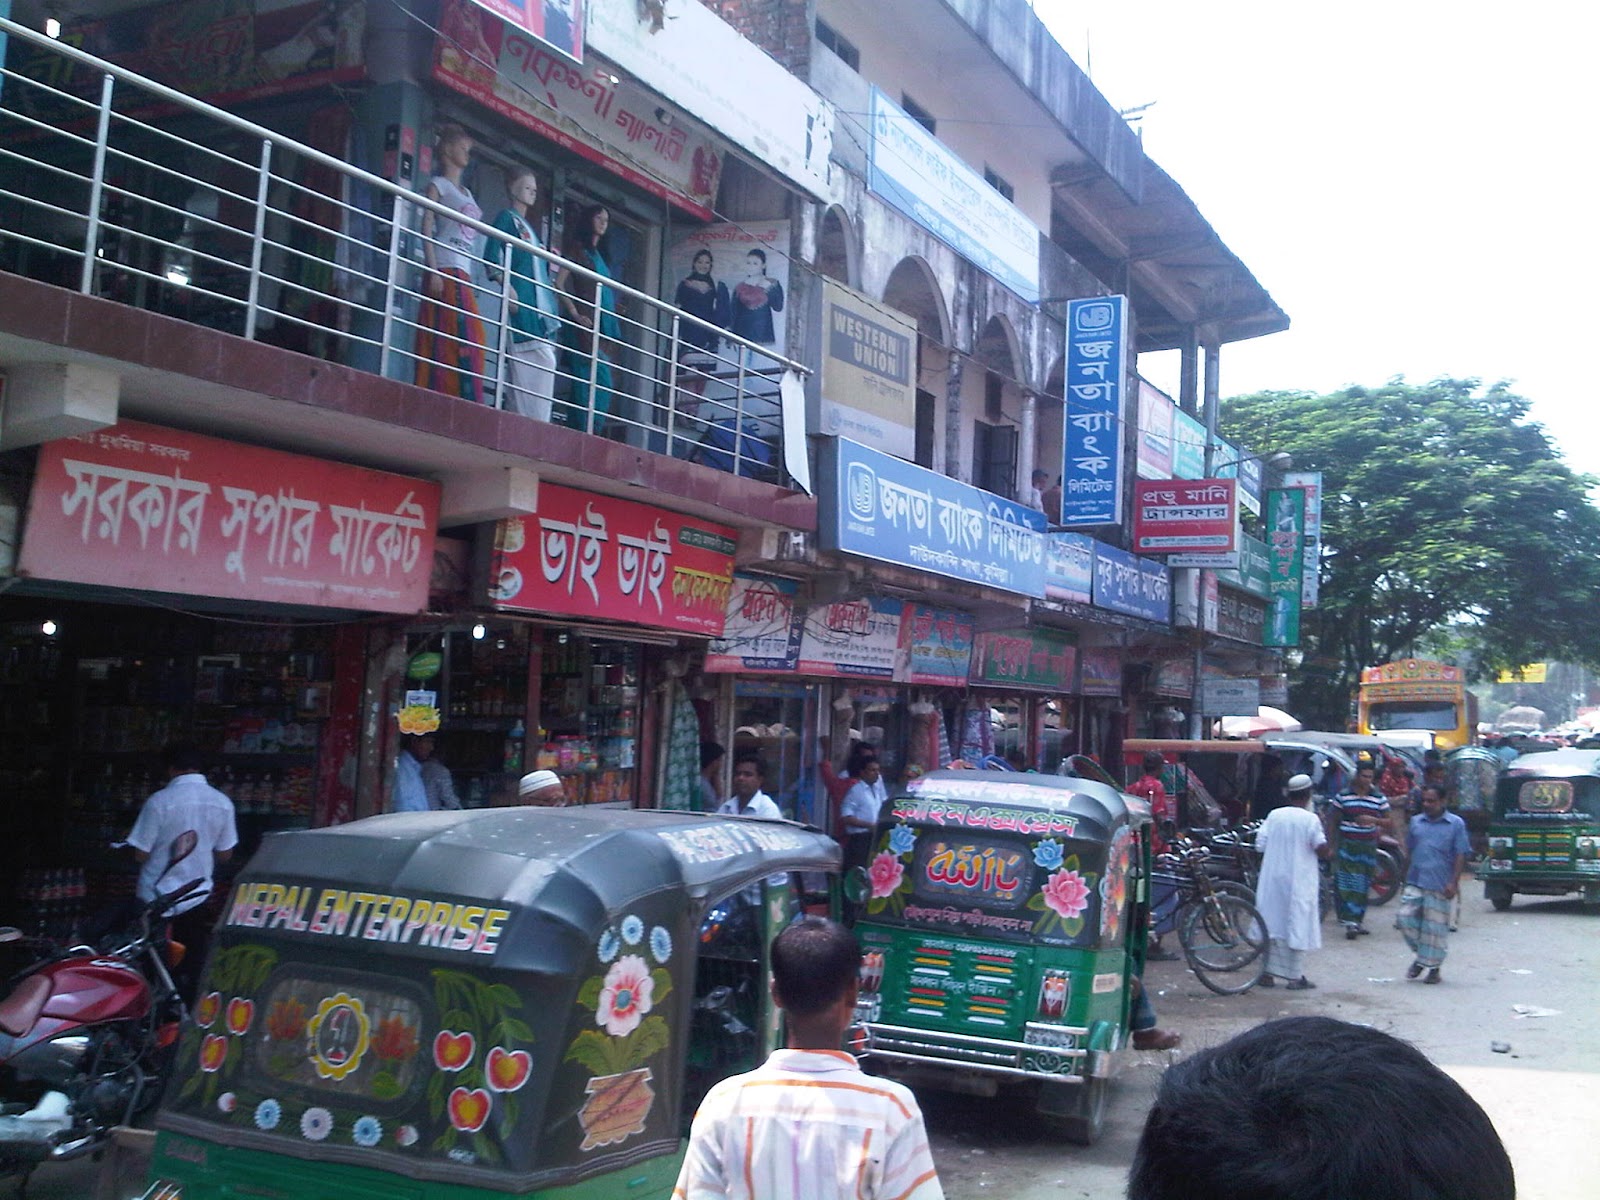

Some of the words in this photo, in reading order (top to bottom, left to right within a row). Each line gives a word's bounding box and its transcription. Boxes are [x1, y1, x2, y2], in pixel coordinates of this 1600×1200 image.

[833, 310, 897, 355] WESTERN
[854, 342, 896, 376] UNION
[62, 458, 212, 556] সরকার
[221, 485, 321, 584] সুপার
[330, 491, 426, 579] মার্কেট
[877, 477, 933, 538] জনতা
[937, 498, 983, 550] ব্যাংক
[986, 502, 1044, 564] লিমিটেড
[1185, 485, 1227, 501] মানি
[539, 502, 609, 608] ভাই
[617, 518, 672, 615] ভাই
[226, 882, 311, 931] NEPAL
[308, 888, 510, 954] ENTERPRISE
